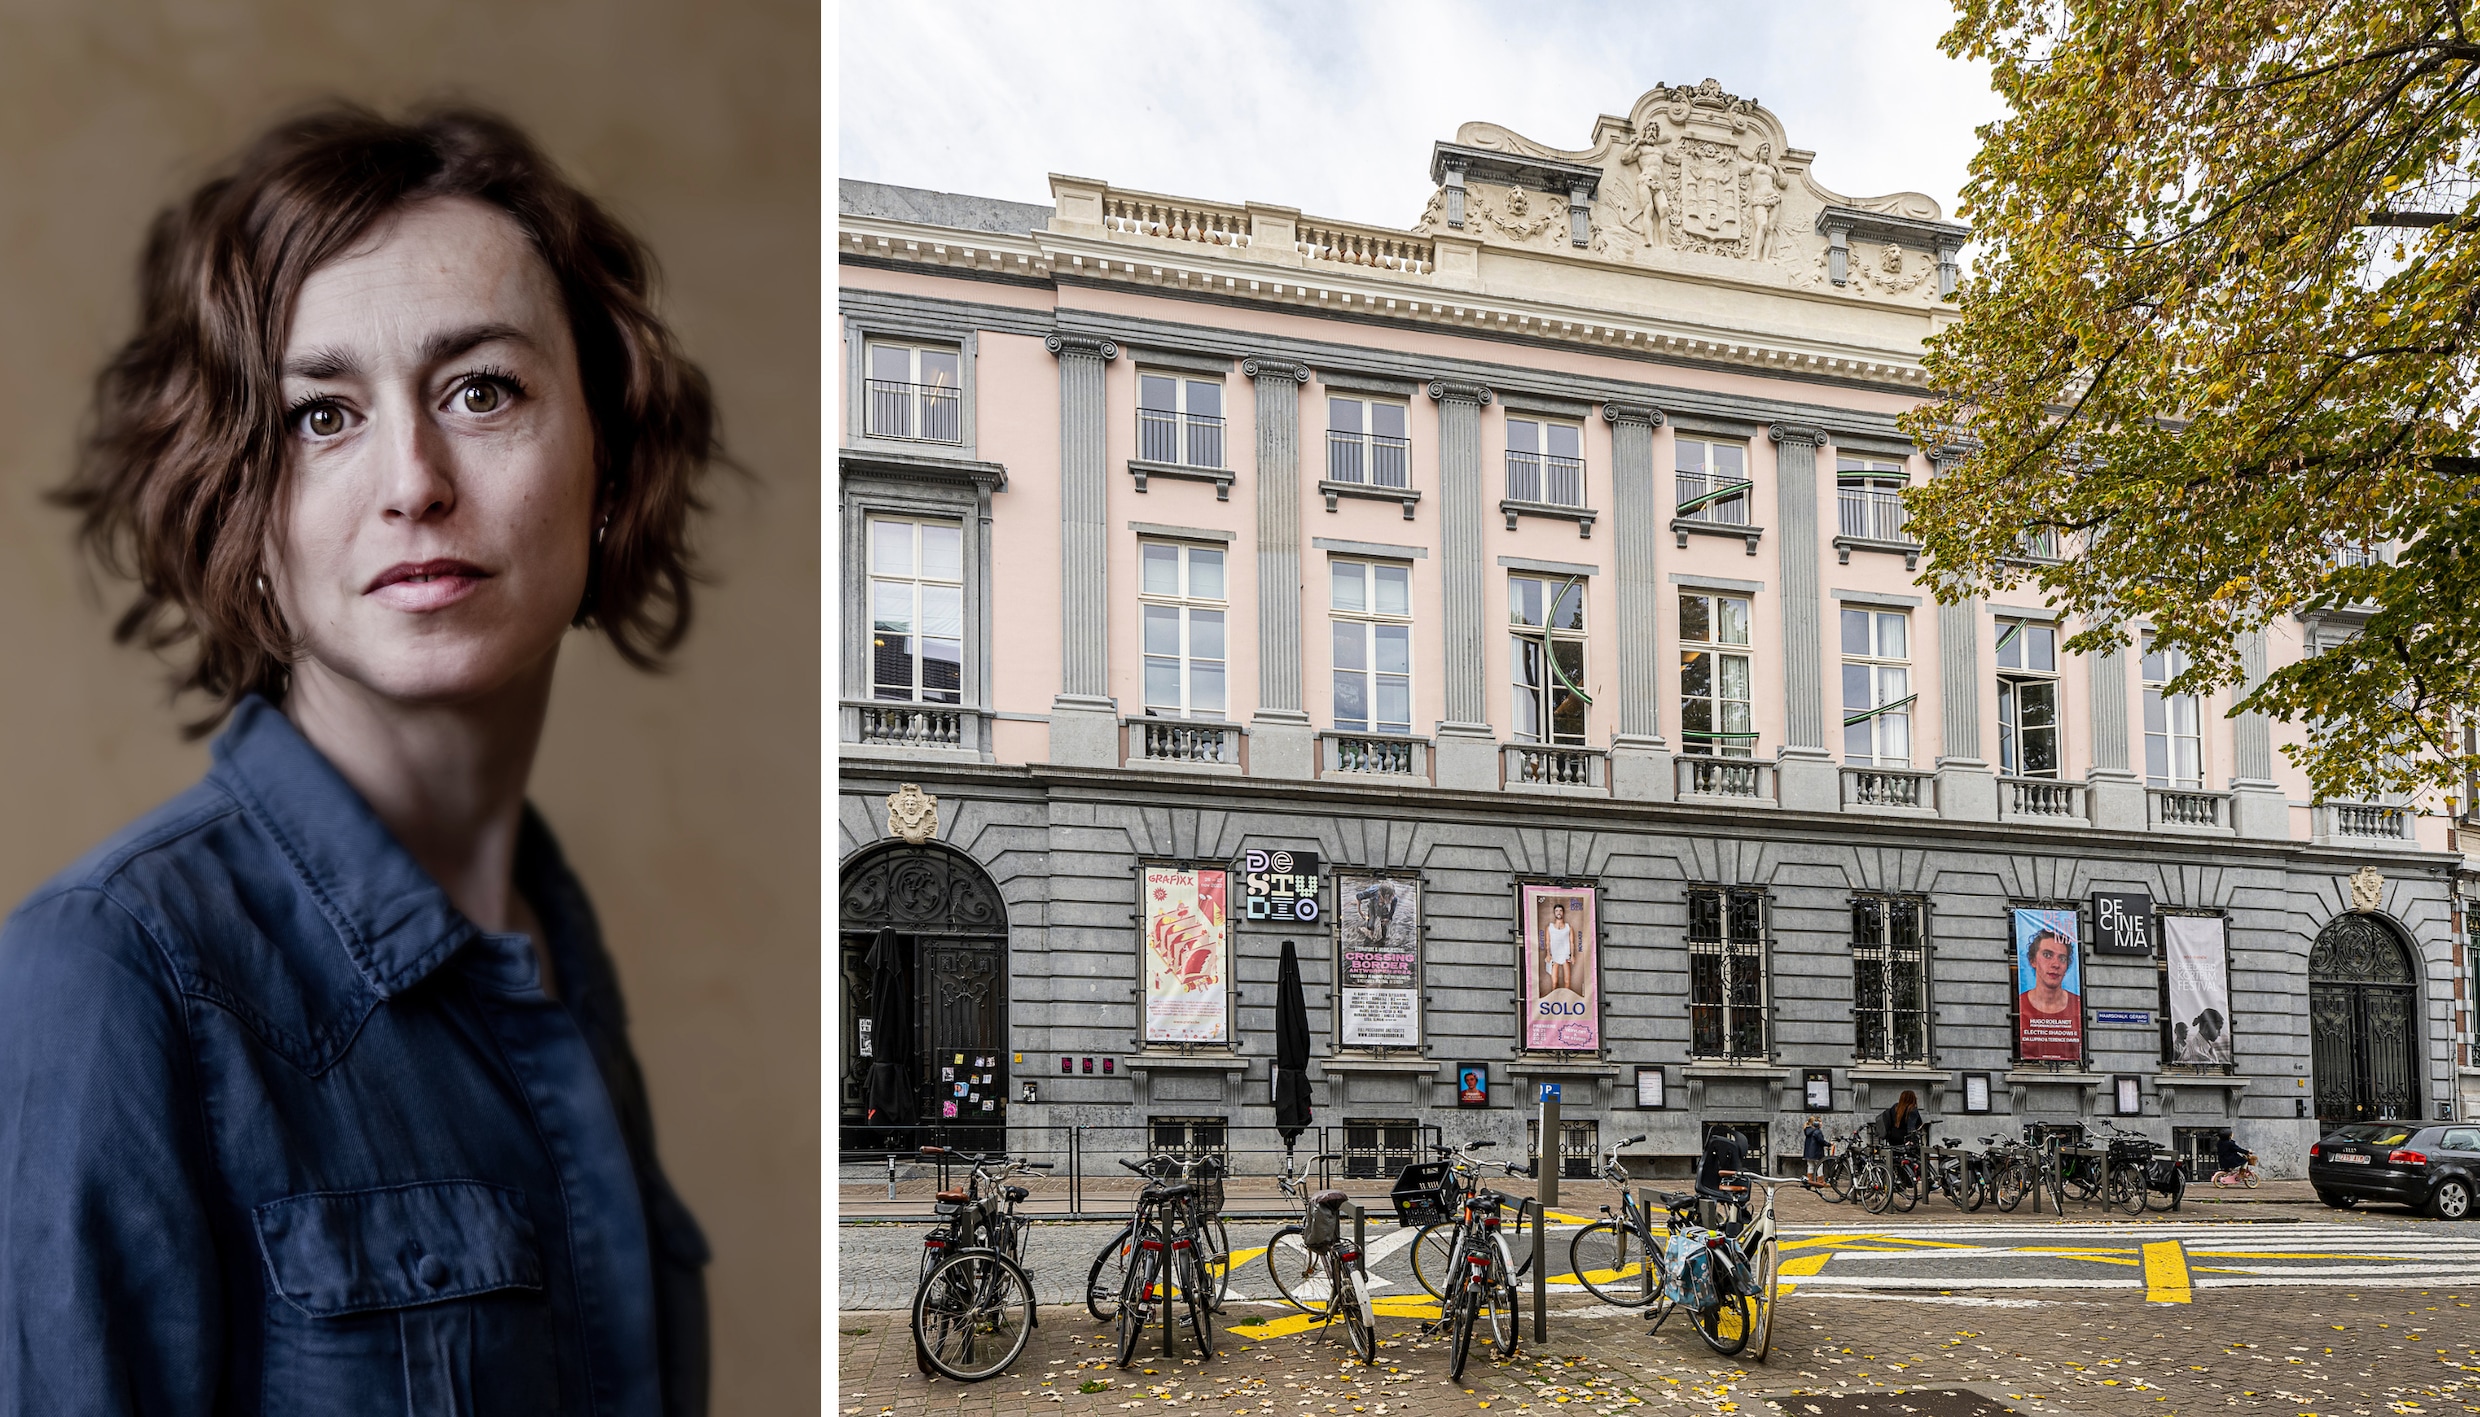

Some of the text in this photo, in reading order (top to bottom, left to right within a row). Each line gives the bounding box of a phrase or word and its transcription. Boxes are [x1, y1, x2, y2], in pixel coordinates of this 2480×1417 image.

[2100, 898, 2123, 915] DE
[2099, 914, 2144, 932] CINE
[2114, 930, 2148, 948] MA
[1345, 952, 1415, 962] CROSSING
[1352, 960, 1408, 970] BORDER
[2178, 981, 2218, 991] FESTIVAL
[1540, 1002, 1585, 1015] SOLO
[1545, 1085, 1553, 1094] P
